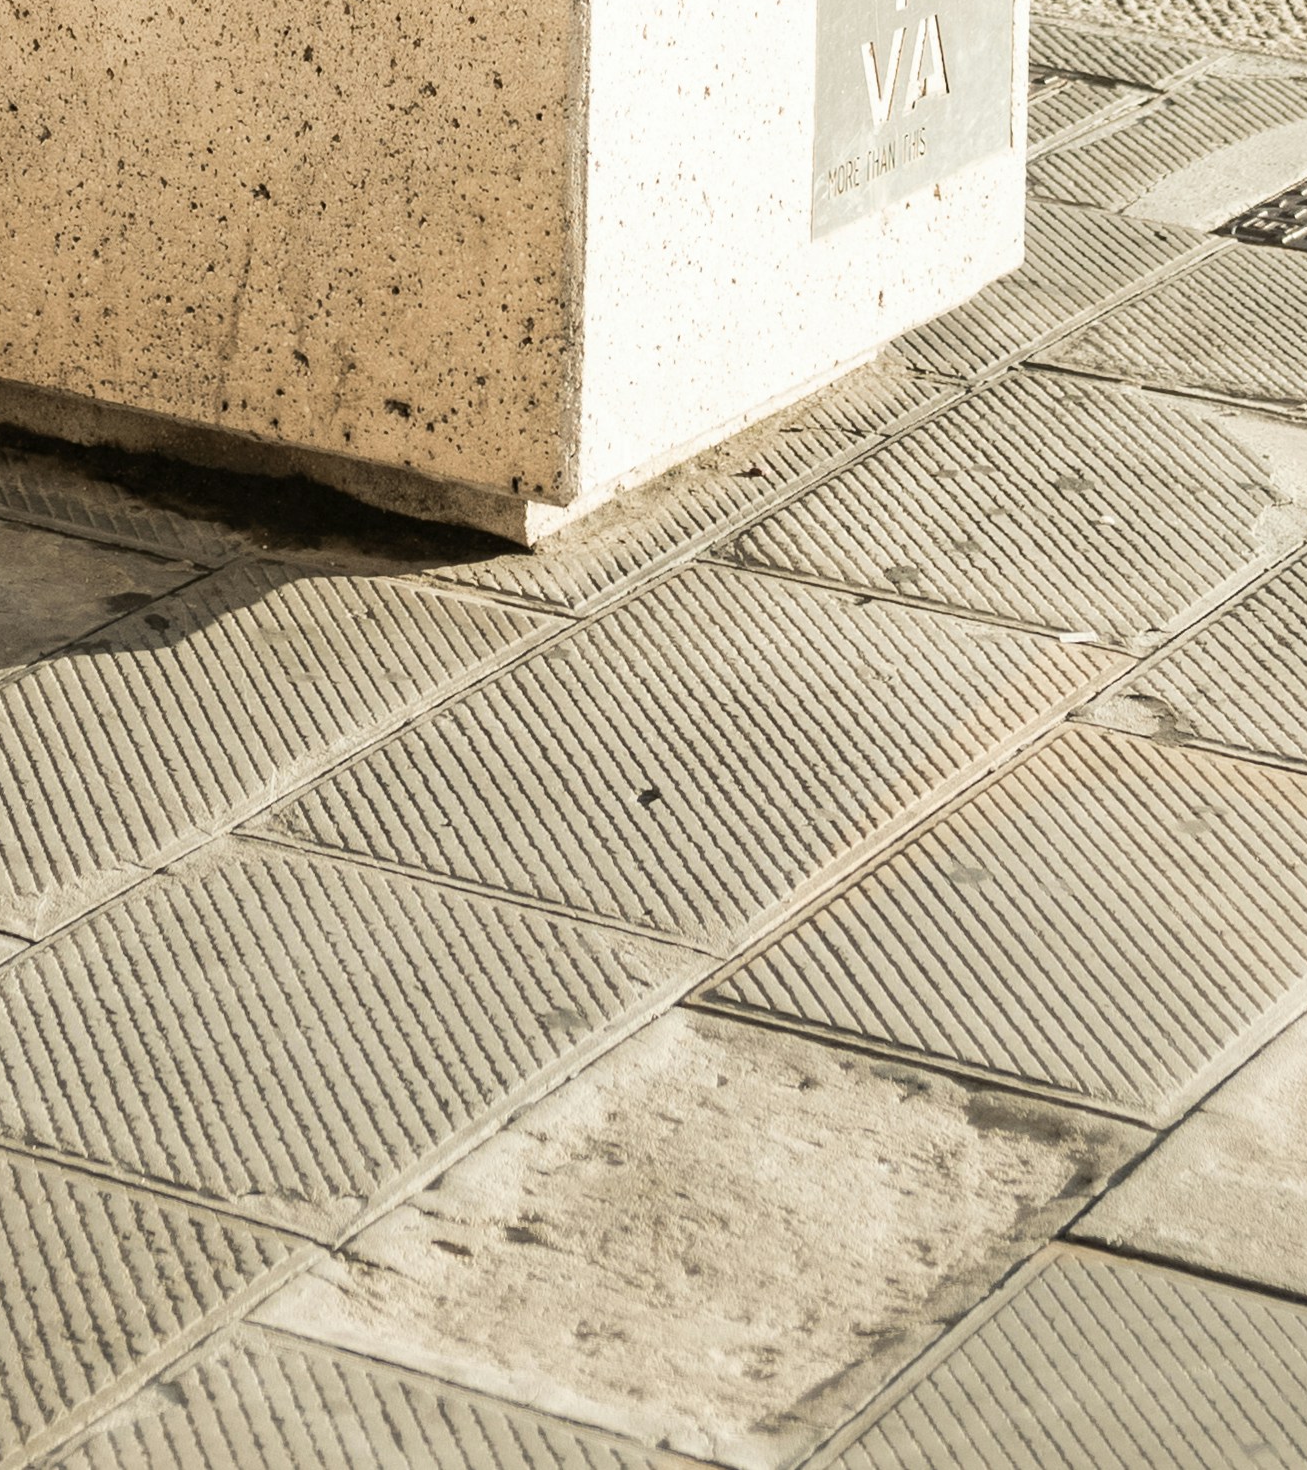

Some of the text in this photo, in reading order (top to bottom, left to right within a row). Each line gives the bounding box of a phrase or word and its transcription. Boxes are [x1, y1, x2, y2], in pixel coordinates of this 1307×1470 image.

[860, 13, 951, 130] VA
[827, 127, 926, 200] MORE THAN THIS
